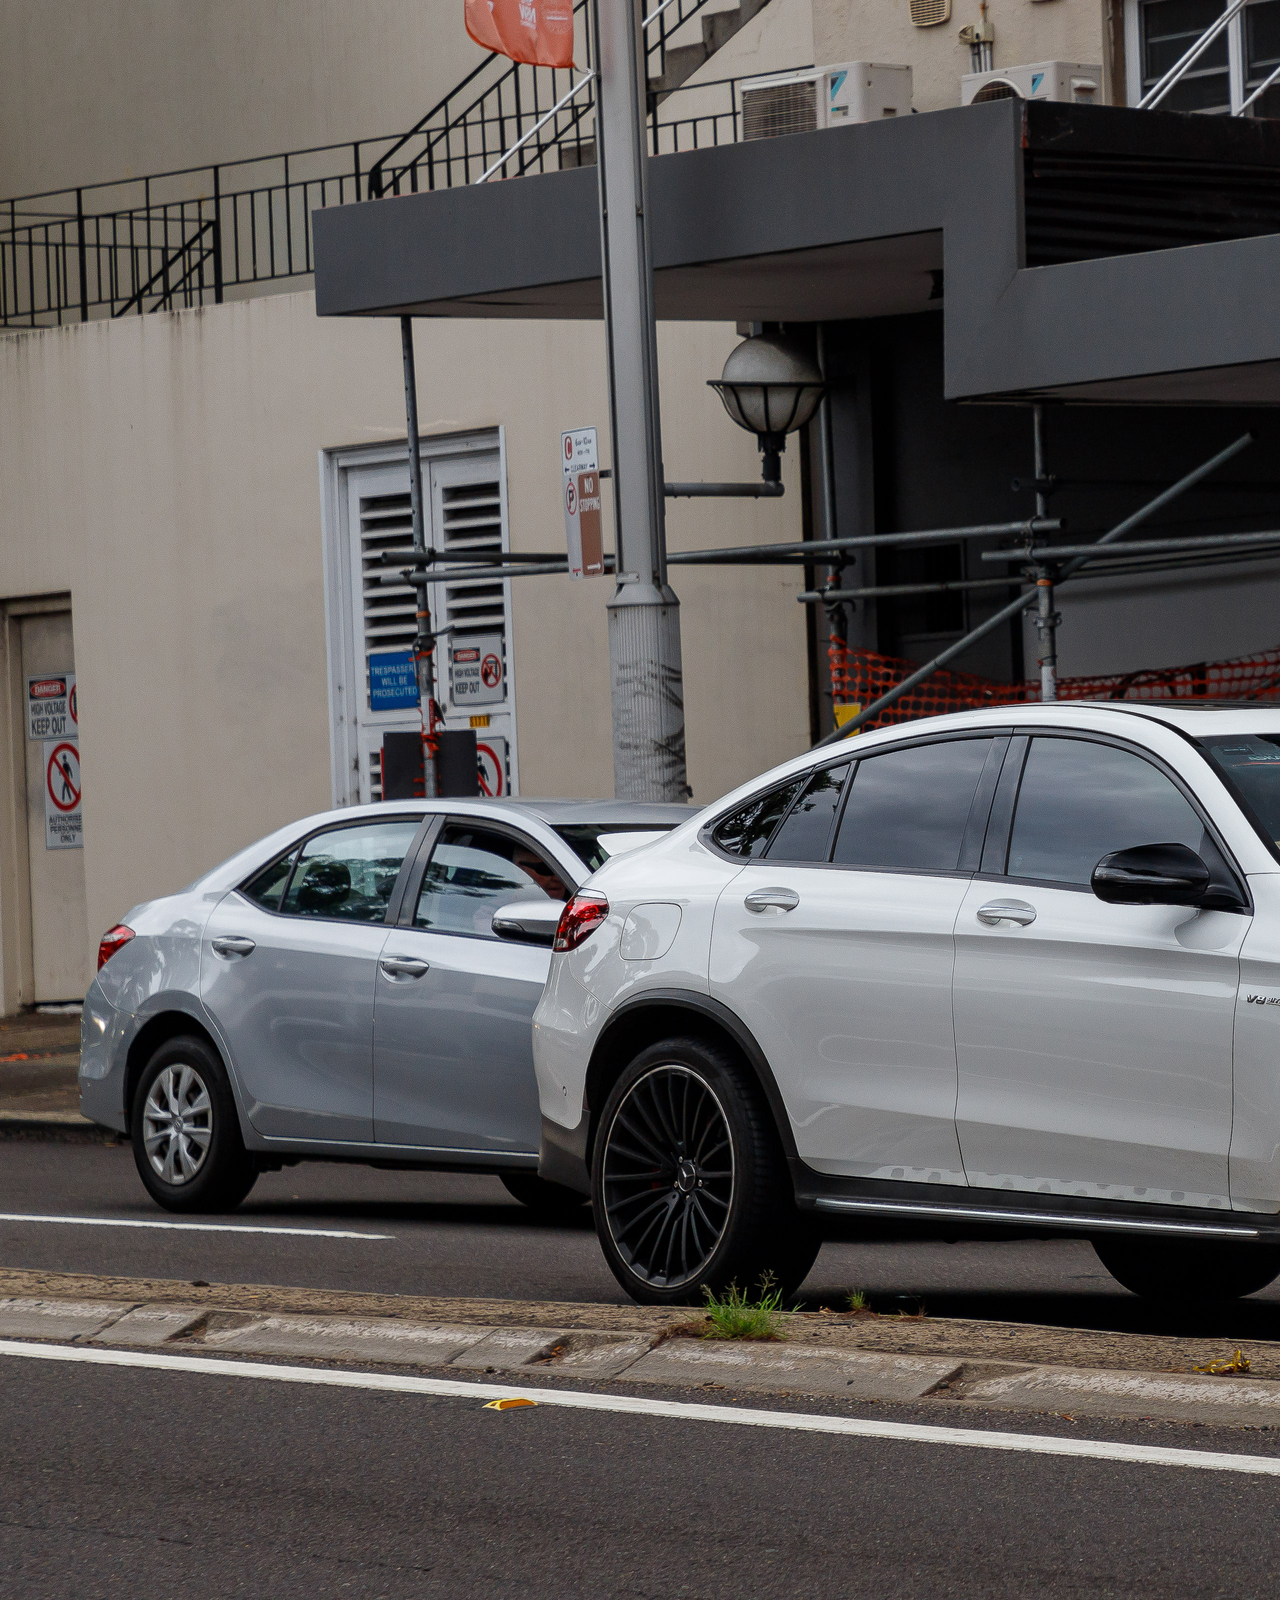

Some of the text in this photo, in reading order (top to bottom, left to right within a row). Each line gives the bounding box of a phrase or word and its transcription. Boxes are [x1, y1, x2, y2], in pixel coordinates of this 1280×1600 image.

[584, 477, 594, 494] NO
[580, 497, 600, 513] STOPPING
[457, 652, 477, 661] DANGER
[371, 664, 414, 675] TRESPASSER
[455, 667, 479, 677] HIGH VOLTAGE
[381, 676, 408, 686] WILL BE
[34, 683, 61, 694] DANGER
[373, 687, 417, 698] PROSECUTED
[455, 681, 480, 693] KEEP OUT
[31, 701, 66, 716] HIGH VOLTAGE
[31, 716, 67, 735] KEEP OUT
[49, 814, 82, 825] AUTHORISE
[49, 823, 82, 834] PERSONNE
[60, 833, 76, 843] ONLY
[1247, 994, 1267, 1005] V8
